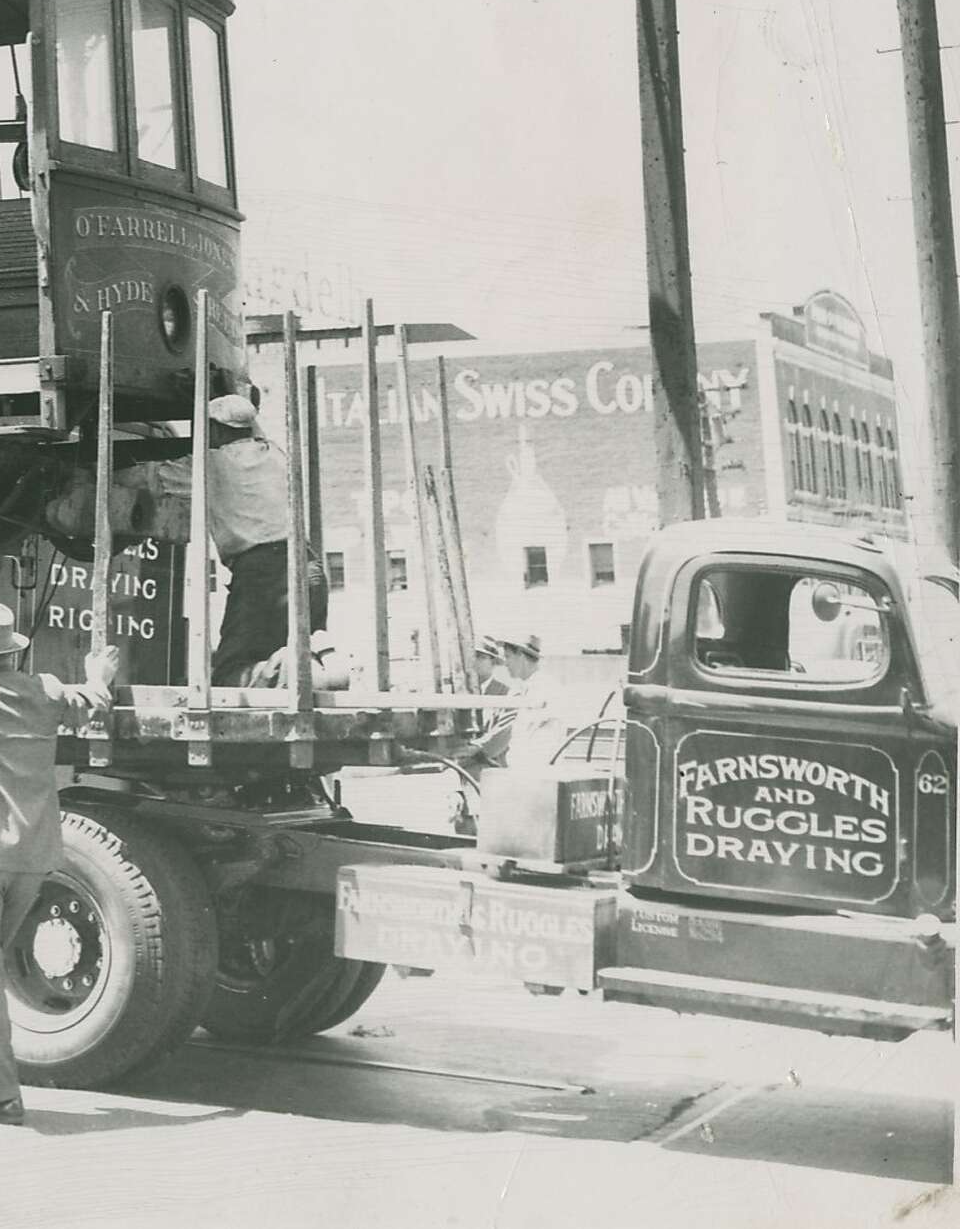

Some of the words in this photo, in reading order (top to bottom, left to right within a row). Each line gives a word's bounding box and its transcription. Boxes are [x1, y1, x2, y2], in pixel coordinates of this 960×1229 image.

[74, 294, 90, 312] &
[98, 281, 154, 311] HYDE
[455, 369, 578, 420] SWISS
[50, 563, 156, 599] DRYING
[48, 605, 155, 639] RIGING
[678, 754, 889, 817] FARNSWORTH
[754, 786, 816, 805] AND
[918, 772, 948, 795] 62
[686, 795, 888, 844] RUGGLES
[686, 833, 885, 877] DRAYING
